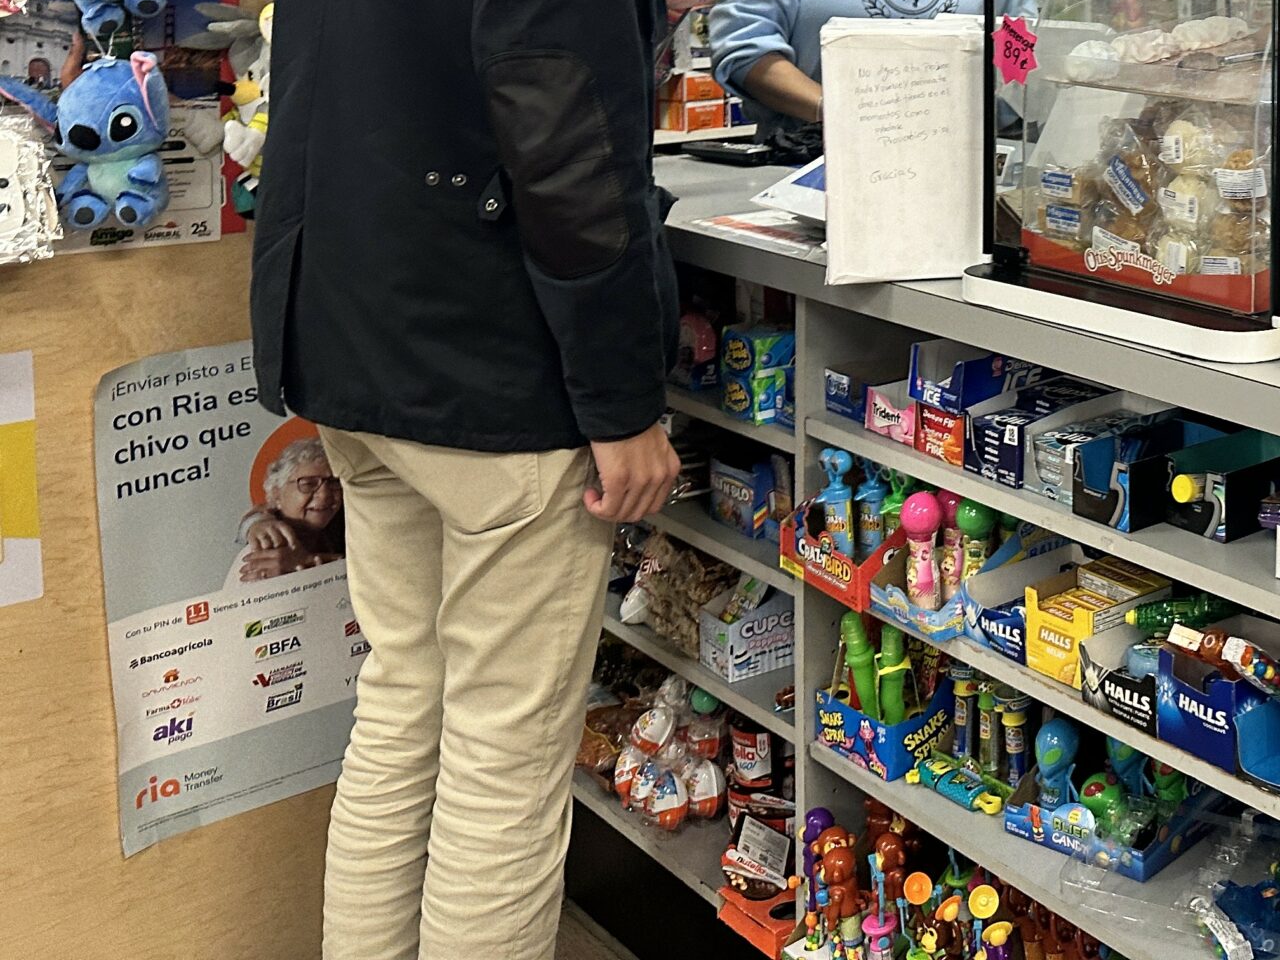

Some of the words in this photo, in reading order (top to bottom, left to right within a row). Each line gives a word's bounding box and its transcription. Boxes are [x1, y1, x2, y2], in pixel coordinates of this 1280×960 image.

[111, 374, 170, 401] ¡Enviar
[175, 365, 219, 386] pisto
[225, 363, 234, 373] a
[112, 405, 162, 431] con
[173, 392, 217, 417] Ria
[228, 387, 258, 406] es
[872, 403, 901, 424] Trident
[922, 390, 942, 406] ICE
[114, 433, 189, 465] chivo
[198, 420, 251, 448] que
[116, 457, 210, 499] nunca!
[798, 539, 826, 569] CRAZY
[824, 559, 851, 583] BIRD
[125, 628, 142, 639] Con
[143, 625, 152, 634] tu
[153, 620, 170, 631] PIN
[172, 616, 183, 626] de
[188, 603, 208, 618] 11
[240, 598, 251, 608] 14
[253, 589, 290, 605] opciones
[291, 585, 301, 594] de
[981, 616, 1021, 642] HALLS
[1040, 628, 1071, 650] HALLS
[140, 637, 213, 666] Bancoagrícola
[268, 637, 301, 655] BFA
[1105, 680, 1150, 712] HALLS
[1179, 693, 1227, 727] HALLS
[153, 711, 196, 742] aki
[819, 710, 843, 726] SNAKE
[903, 709, 947, 751] SNAKE
[168, 730, 193, 745] pago
[184, 766, 218, 782] Money
[136, 775, 180, 810] ria
[184, 774, 223, 792] Transfer
